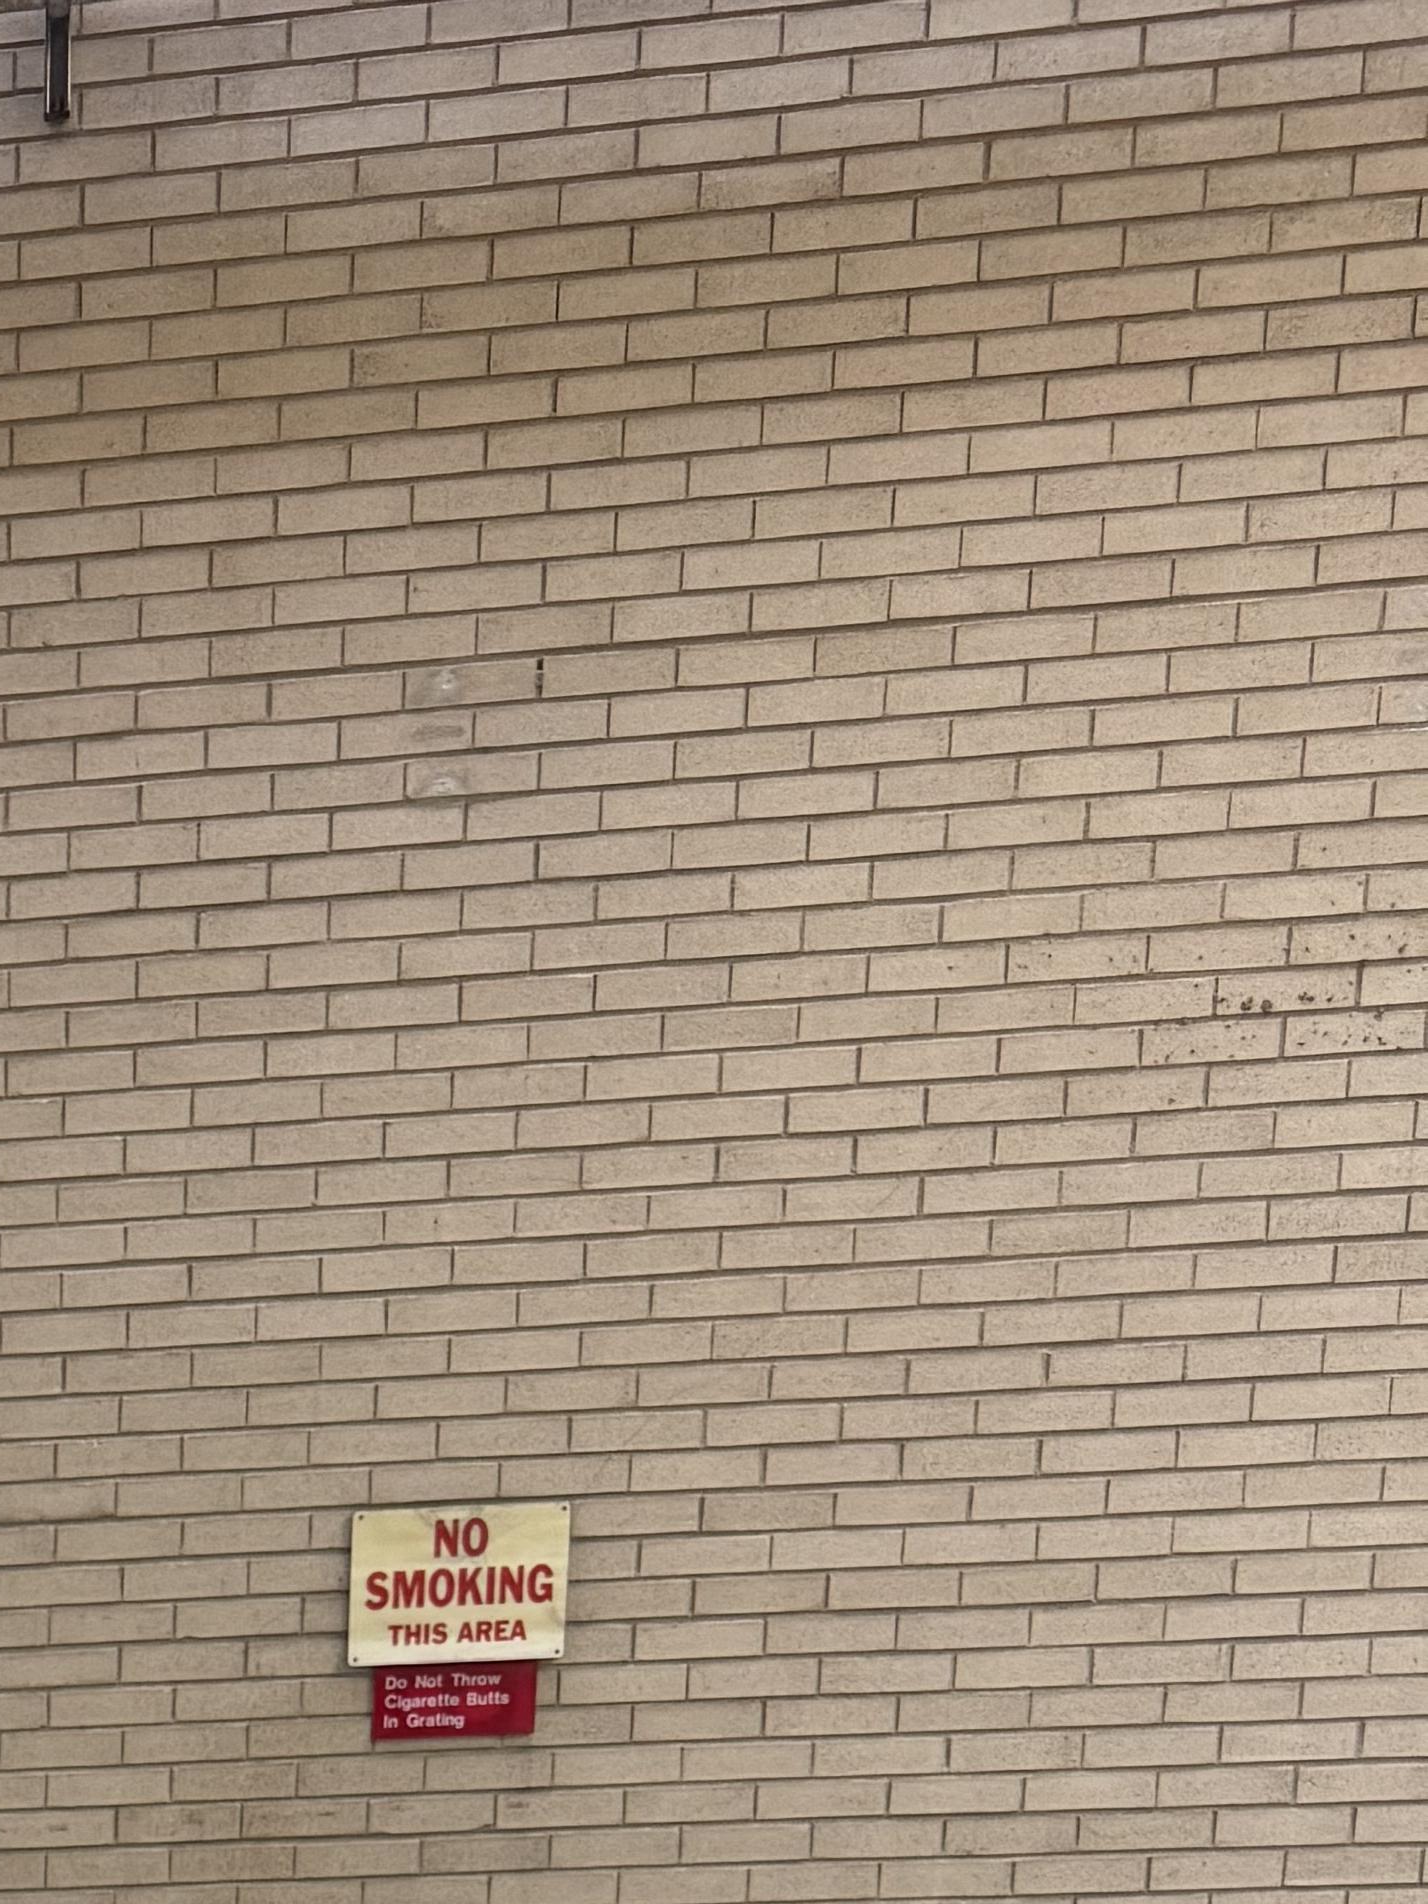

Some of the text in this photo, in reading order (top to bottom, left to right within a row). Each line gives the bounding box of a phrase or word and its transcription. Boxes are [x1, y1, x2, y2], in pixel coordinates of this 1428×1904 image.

[433, 1517, 489, 1558] NO
[365, 1564, 553, 1611] SMOKING
[388, 1620, 526, 1646] THIS AREA
[385, 1673, 501, 1690] Do Not Throw
[385, 1692, 509, 1711] Cigarette Butts
[384, 1713, 465, 1728] In Grating
